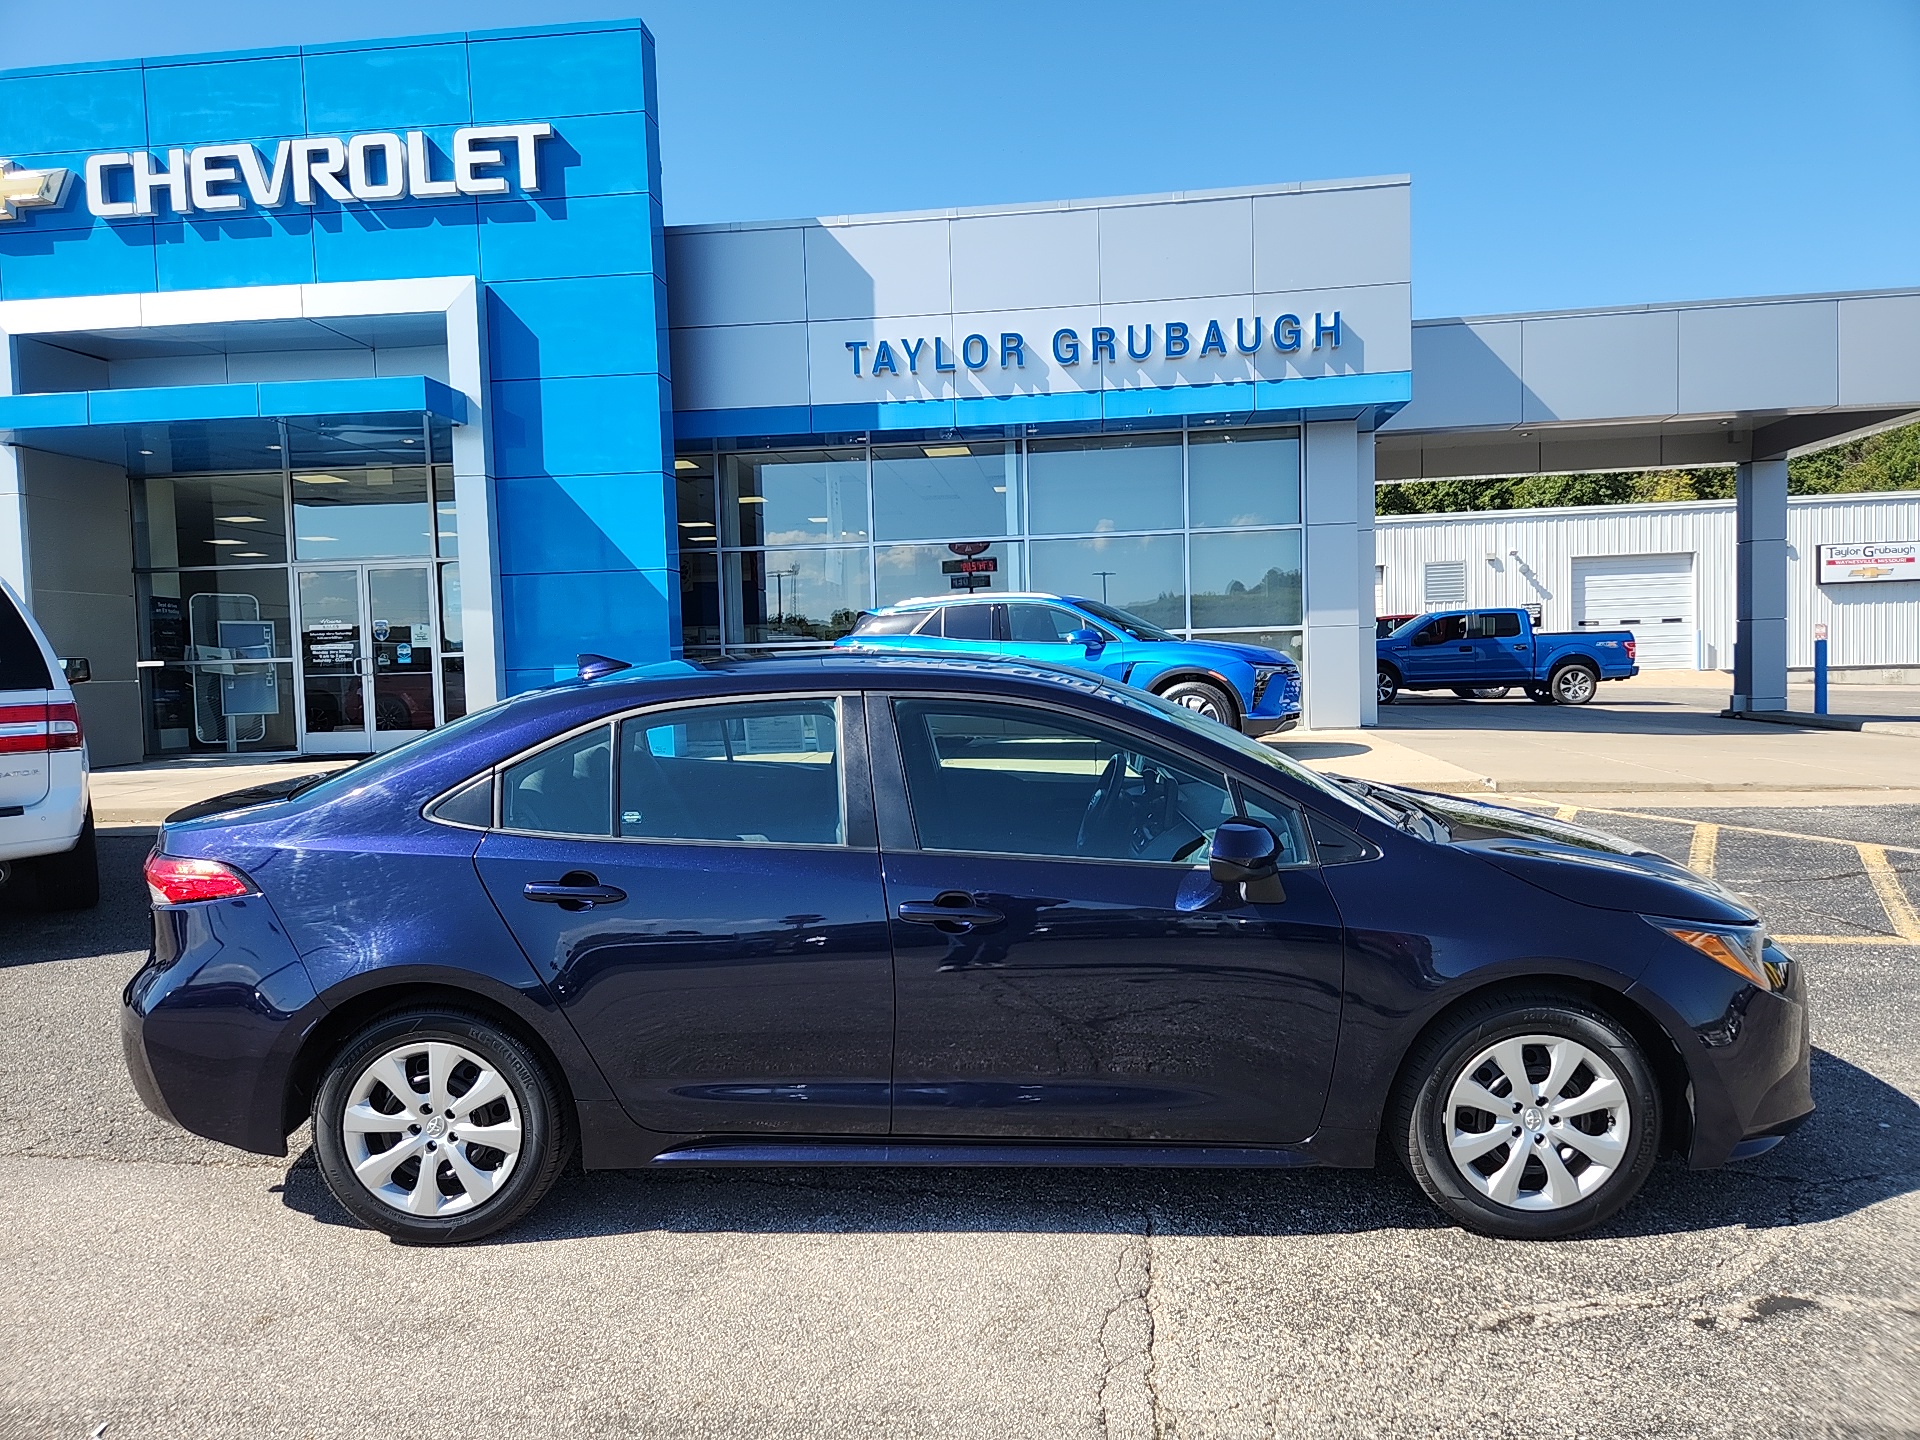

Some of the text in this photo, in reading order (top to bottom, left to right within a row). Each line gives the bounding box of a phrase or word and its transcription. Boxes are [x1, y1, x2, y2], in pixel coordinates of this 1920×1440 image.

[85, 123, 554, 219] CHEVROLET
[845, 311, 1343, 377] TAYLOR GRUBAUGH
[1826, 545, 1916, 558] Taylor Grubaugh
